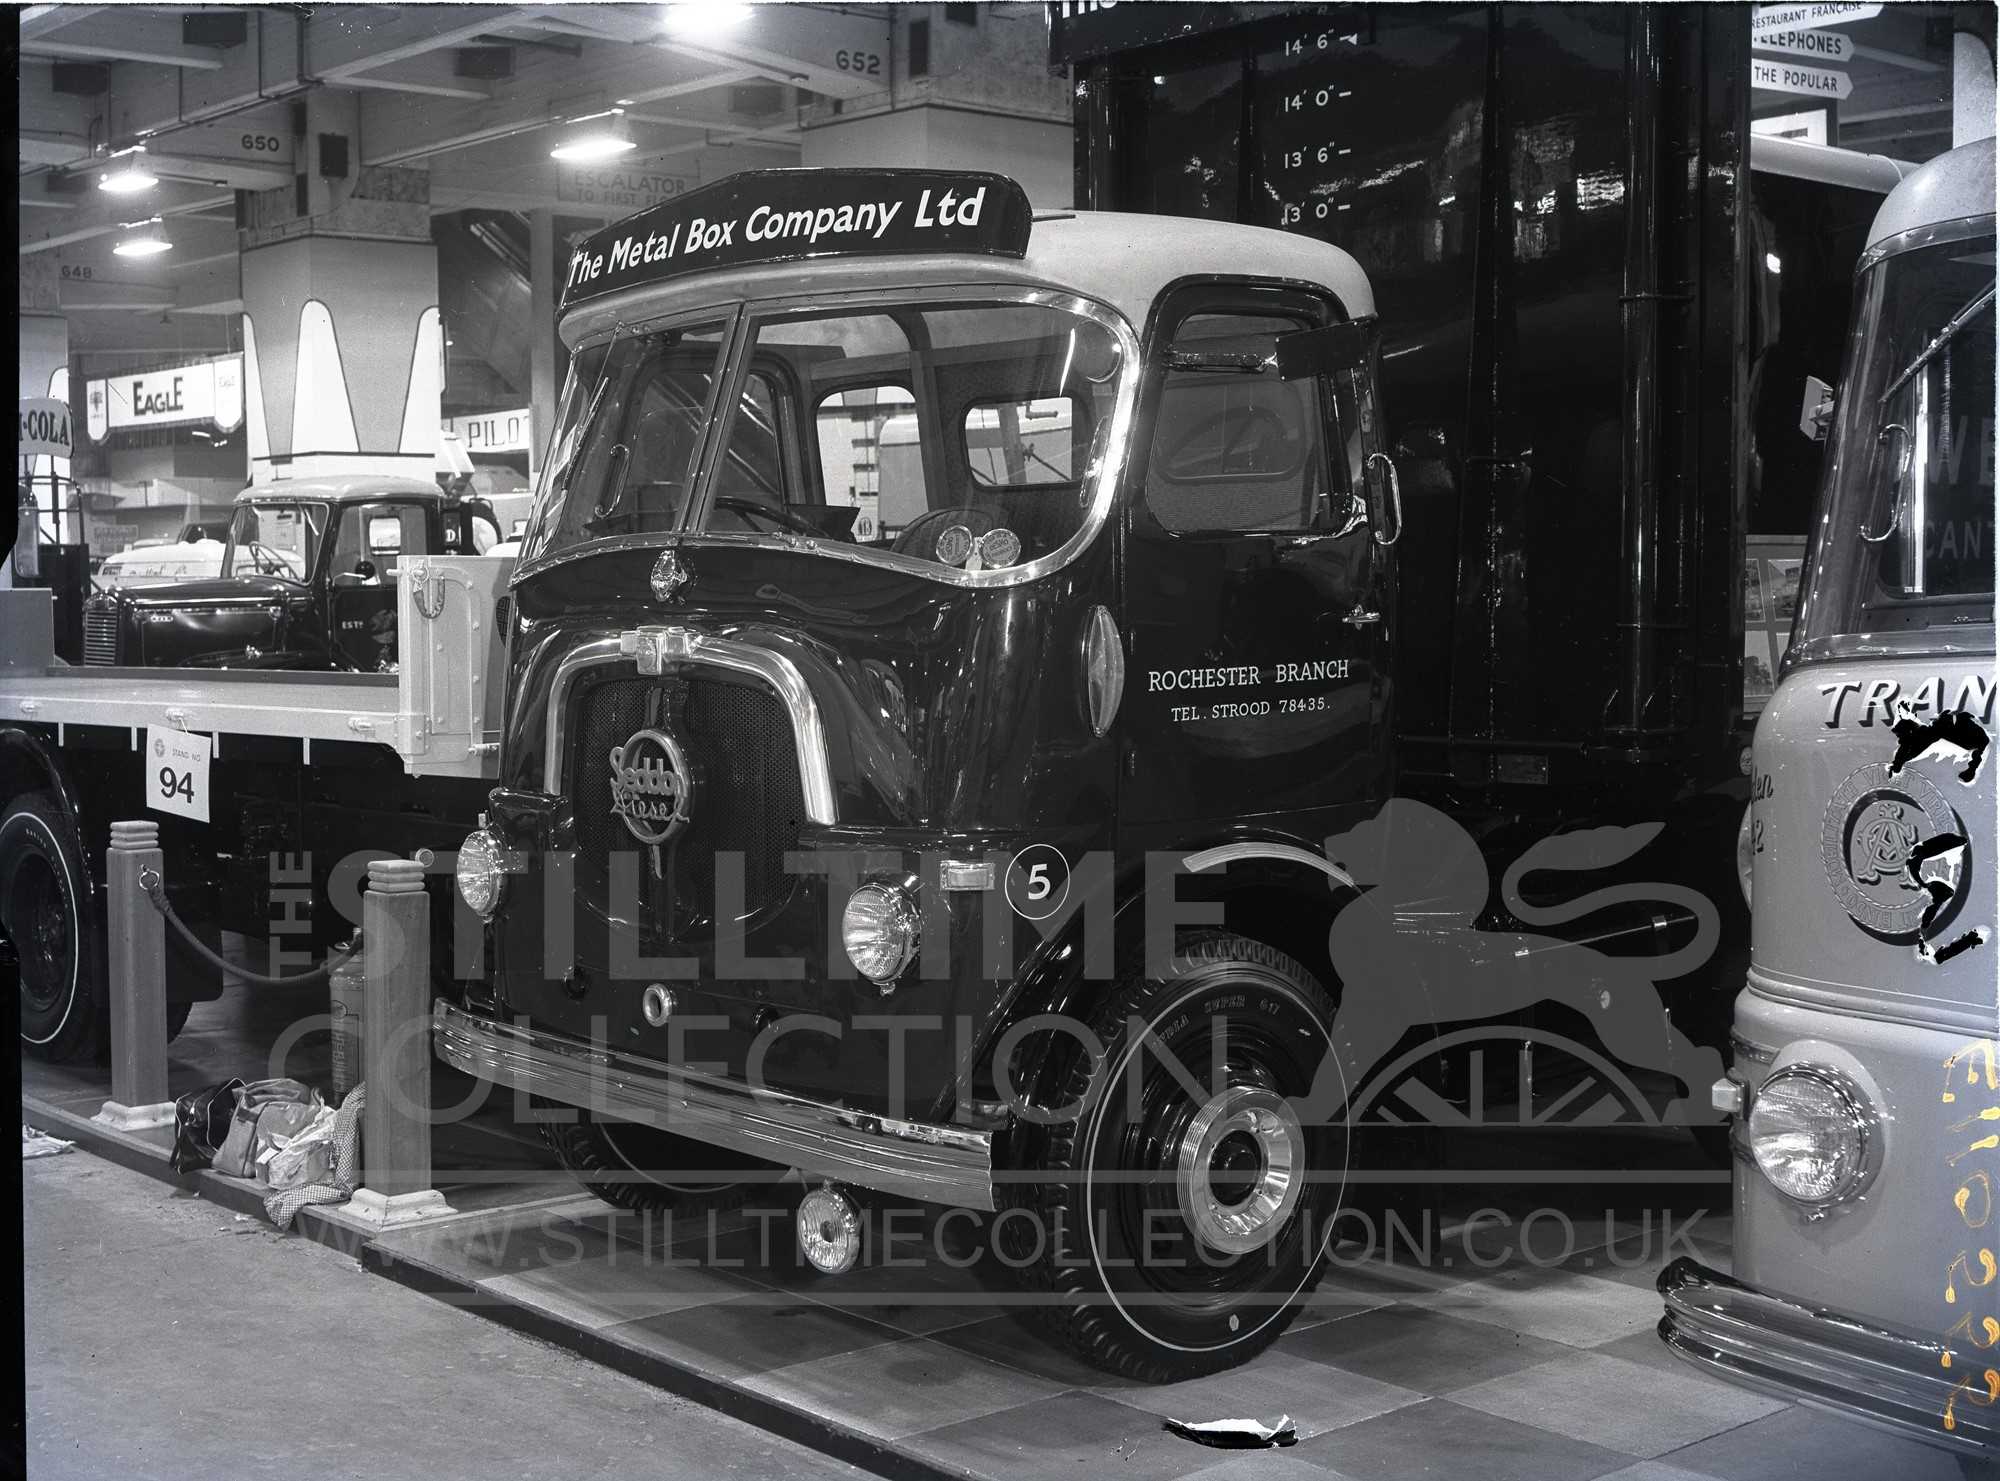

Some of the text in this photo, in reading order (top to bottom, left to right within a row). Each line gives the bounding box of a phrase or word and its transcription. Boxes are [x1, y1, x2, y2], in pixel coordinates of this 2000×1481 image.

[1752, 9, 1807, 29] RESTAURANT
[1753, 32, 1842, 55] ELEPHONES
[836, 50, 881, 75] 652
[1754, 66, 1777, 83] THE
[241, 134, 280, 153] 650
[568, 186, 986, 287] The Metal Box Company Ltd
[133, 376, 184, 417] EAGLE
[468, 415, 529, 448] PILO
[1148, 659, 1349, 692] ROCHESTER BRANCH
[1171, 706, 1208, 722] TEL.
[1211, 700, 1271, 719] STROOD
[159, 766, 195, 804] 94
[1027, 863, 1052, 900] 5
